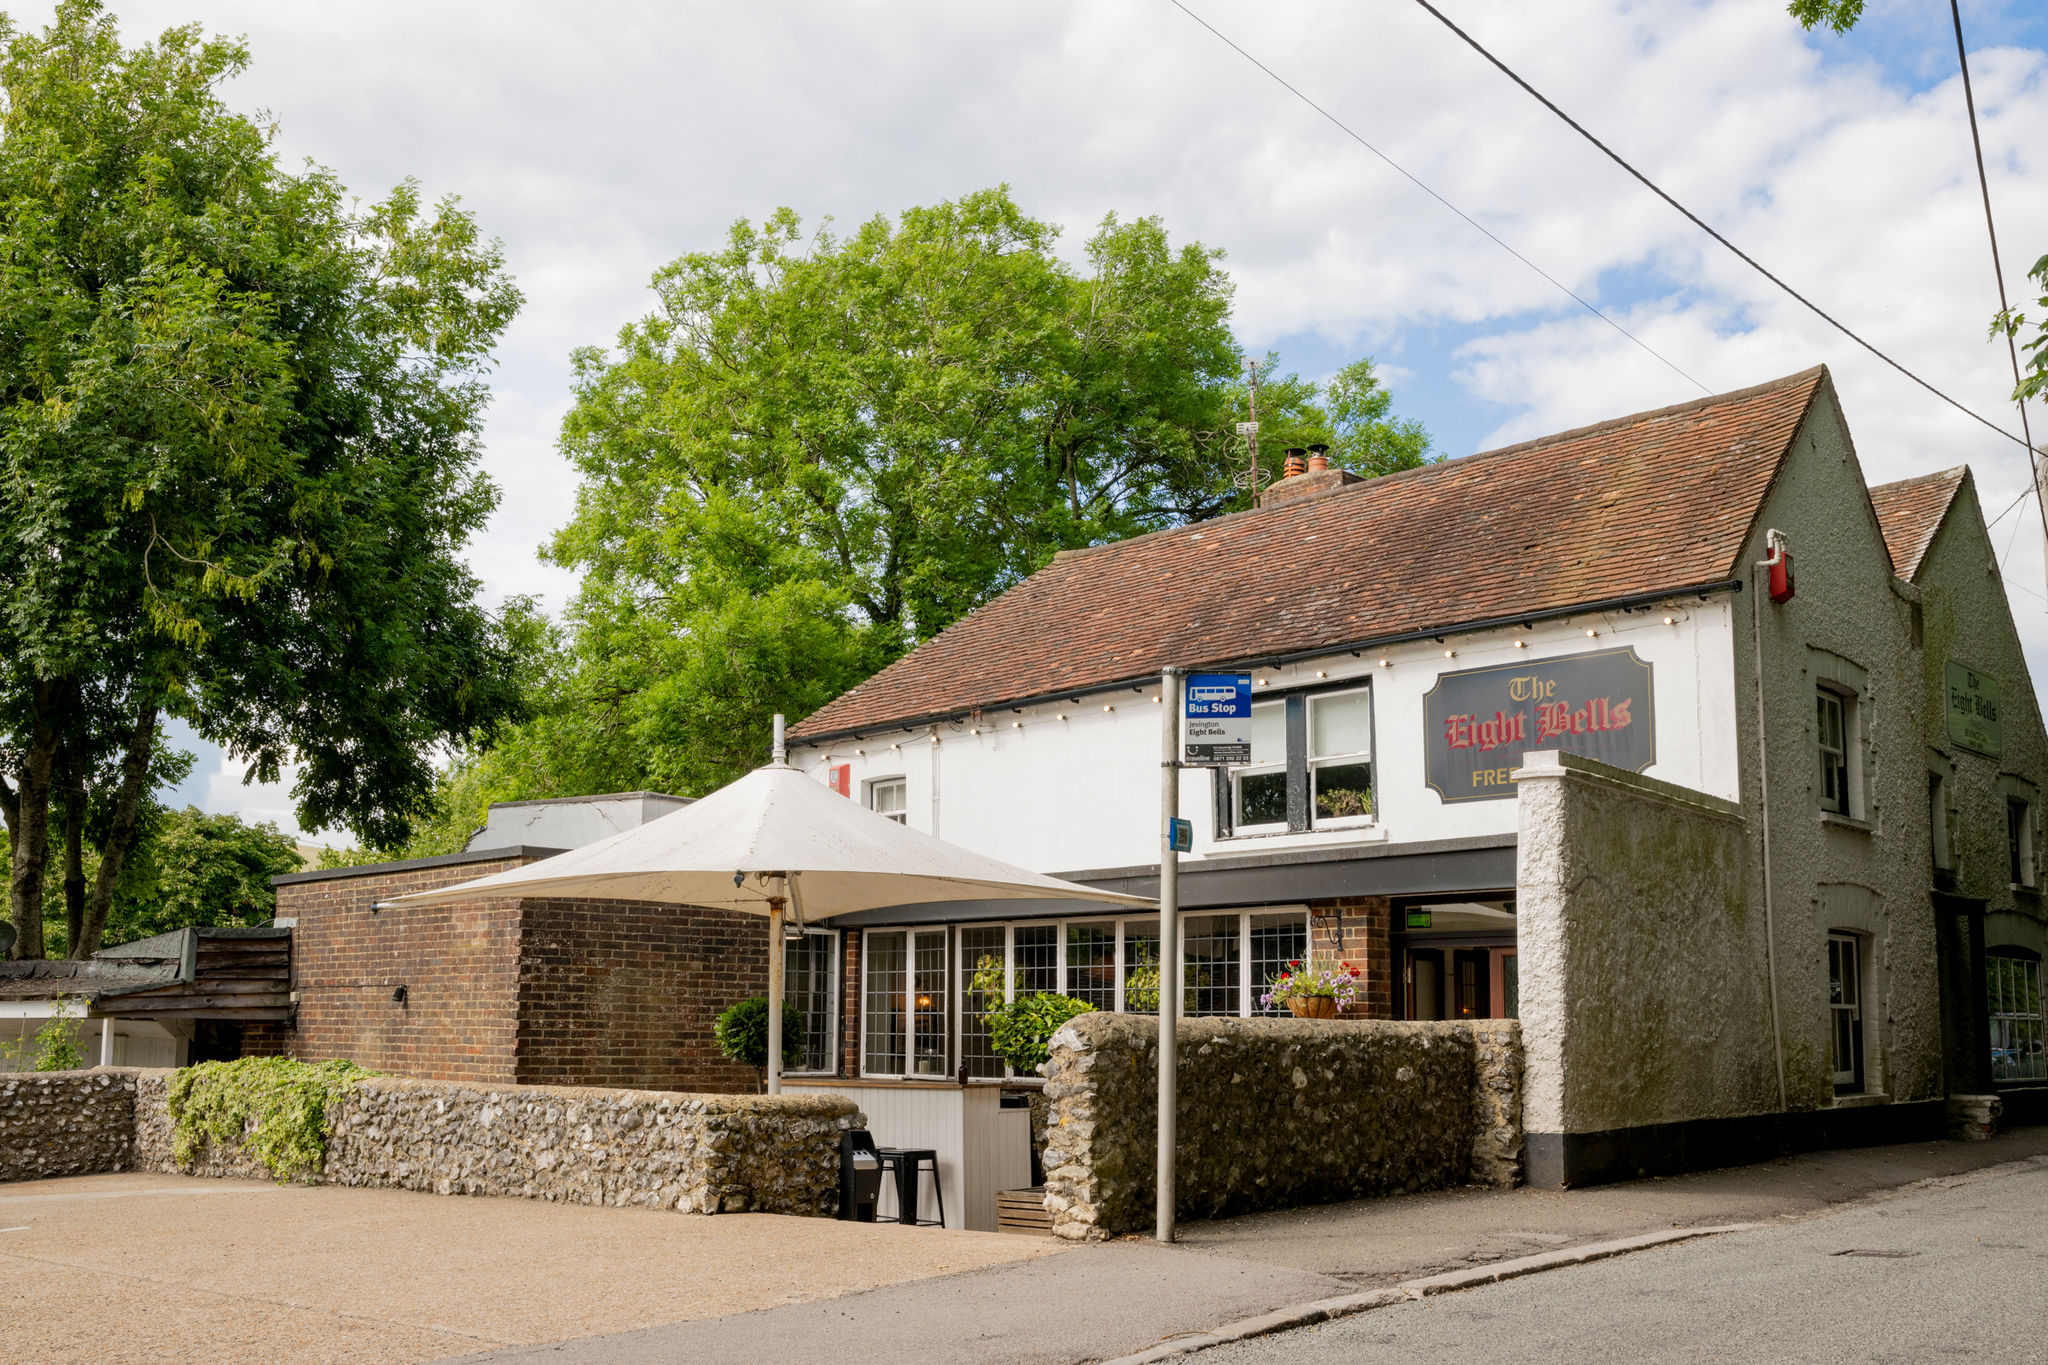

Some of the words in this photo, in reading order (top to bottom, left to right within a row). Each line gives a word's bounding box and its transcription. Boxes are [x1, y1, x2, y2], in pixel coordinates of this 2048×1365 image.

[1508, 675, 1557, 704] The
[1188, 703, 1209, 713] Bus
[1211, 702, 1236, 715] Stop
[1951, 686, 1973, 717] Eight
[1974, 694, 1997, 722] Bells
[1189, 721, 1219, 729] Jevington
[1189, 729, 1207, 737] Eight
[1443, 709, 1528, 752] Eight
[1534, 696, 1632, 745] Bells
